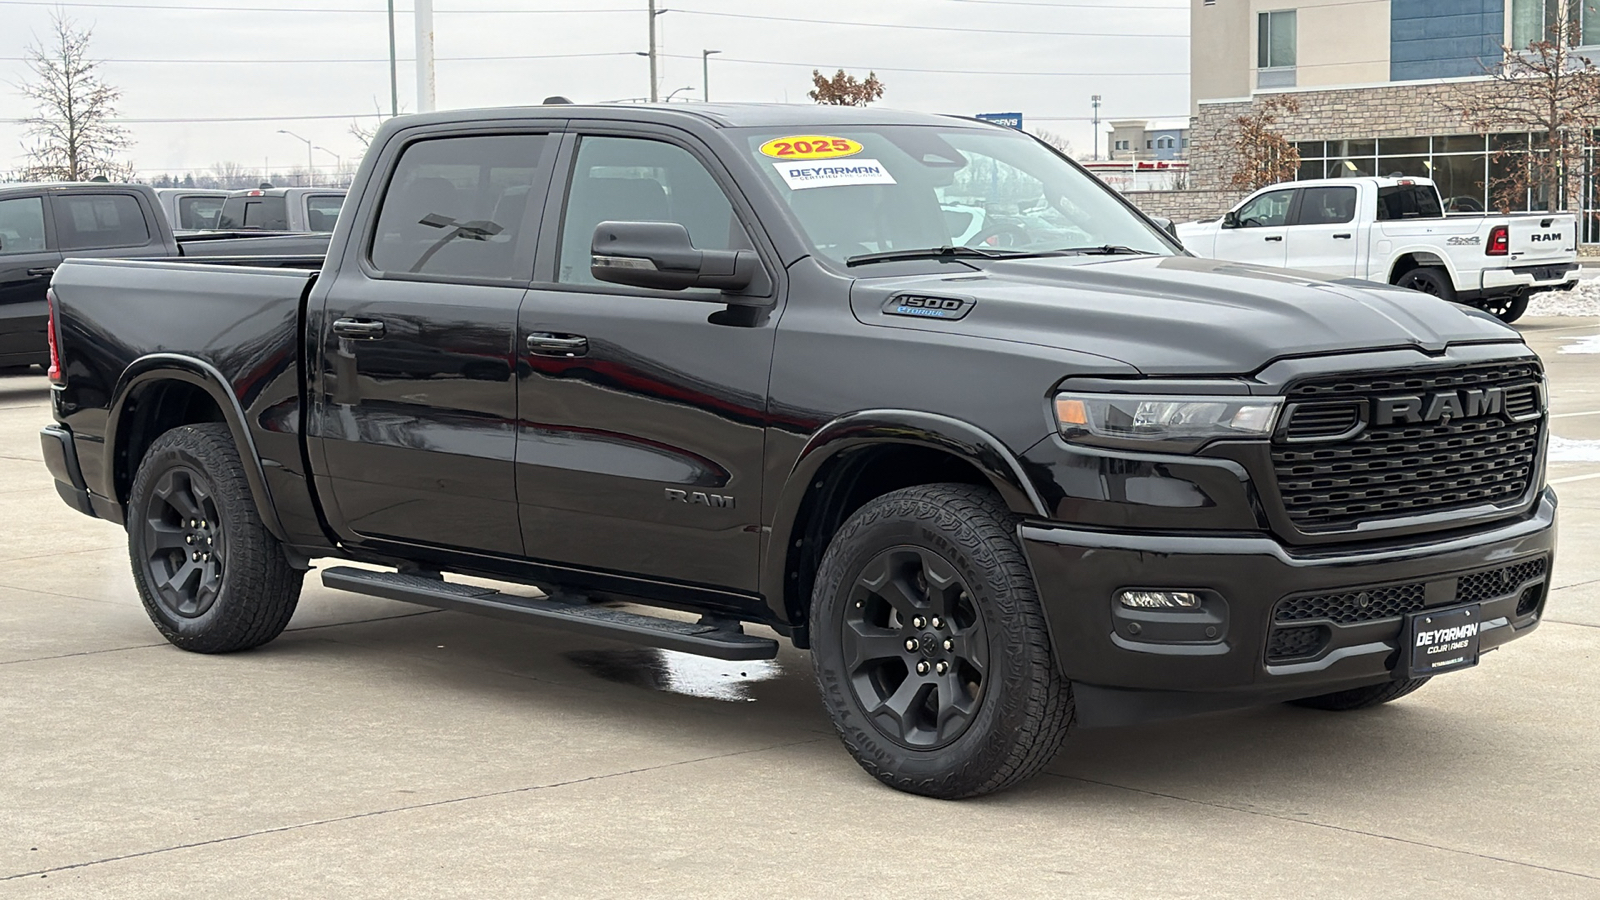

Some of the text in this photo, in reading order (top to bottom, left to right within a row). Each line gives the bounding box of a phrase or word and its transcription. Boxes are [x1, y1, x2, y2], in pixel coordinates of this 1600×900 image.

[773, 139, 851, 156] 2025
[789, 166, 880, 178] DEYARMAN
[1531, 233, 1562, 242] RAM
[900, 296, 960, 310] 1500
[1377, 387, 1501, 425] RAM
[664, 487, 736, 509] RAM
[1416, 622, 1479, 647] DEYARMAN
